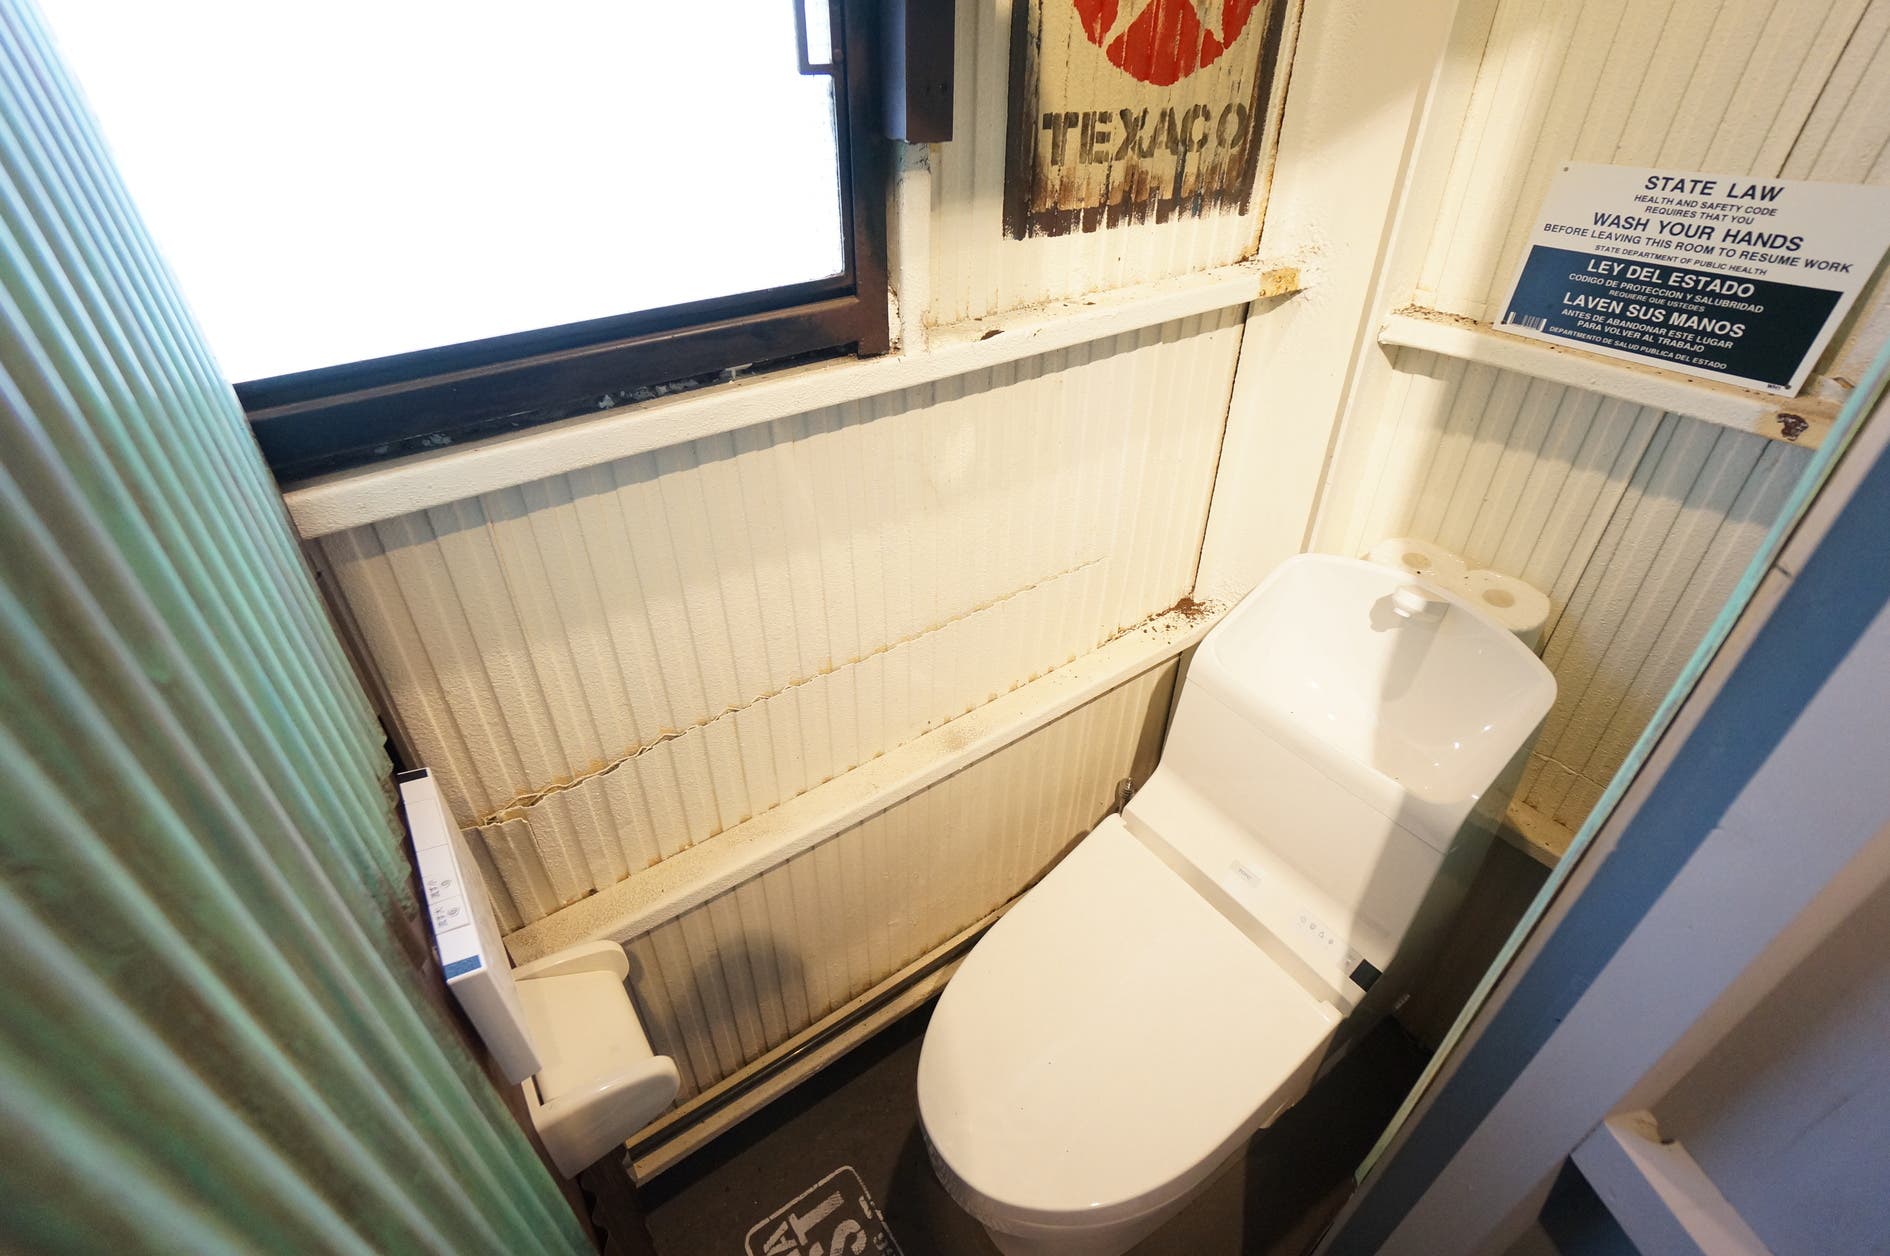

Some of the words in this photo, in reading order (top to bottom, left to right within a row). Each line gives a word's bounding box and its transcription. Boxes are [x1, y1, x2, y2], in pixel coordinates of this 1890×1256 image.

[1042, 102, 1250, 166] TEXACO
[1634, 194, 1674, 206] HEALTH
[1675, 199, 1698, 208] AND
[1700, 202, 1743, 212] SAFETY
[1745, 206, 1778, 216] CODE
[1645, 175, 1717, 196] STATE
[1726, 183, 1785, 201] LAW
[1593, 212, 1650, 232] WASH
[1658, 220, 1715, 241] YOUR
[1722, 228, 1804, 252] HANDS
[1644, 205, 1697, 219] REQUIRES
[1700, 212, 1728, 222] THAT
[1731, 216, 1755, 225] YOU
[1544, 223, 1588, 237] BEFORE
[1591, 229, 1642, 245] LEAVING
[1645, 237, 1672, 249] THIS
[1674, 241, 1715, 255] ROOM
[1718, 247, 1736, 258] TO
[1739, 250, 1801, 267] RESUME
[1804, 259, 1854, 273] WORK
[1594, 244, 1621, 255] STATE
[1621, 248, 1679, 263] DEPARTMENT
[1680, 257, 1692, 265] OF
[1693, 259, 1727, 270] PUBLIC
[1728, 265, 1768, 276] HEALTH
[1569, 273, 1604, 285] CODIGO
[1605, 279, 1619, 288] DE
[1620, 282, 1684, 300] PROTECCION
[1686, 293, 1693, 301] Y
[1694, 295, 1764, 313] SALUBRIDAD
[1587, 259, 1625, 276] LEY
[1626, 265, 1662, 283] DEL
[1668, 272, 1755, 298] ESTADO
[1563, 291, 1624, 314] LAVEN
[1626, 304, 1666, 322] SUS
[1668, 312, 1746, 338] MANOS
[1608, 289, 1648, 302] REQUIERE
[1649, 296, 1666, 305] QUE
[1667, 300, 1705, 312] USTEDES
[1561, 308, 1591, 320] ANTES
[1592, 314, 1606, 323] DE
[1606, 318, 1667, 336] ABANDONAR
[1668, 330, 1695, 341] ESTE
[1696, 335, 1734, 349] LUGAR
[1577, 320, 1602, 331] PARA
[1604, 325, 1641, 339] VOLVER
[1642, 334, 1654, 342] AL
[1658, 336, 1705, 353] TRABAJO
[1602, 337, 1612, 345] DE
[1613, 340, 1640, 351] SALUD
[1640, 345, 1674, 358] PUBLICA
[1674, 353, 1691, 362] DEL
[1692, 357, 1727, 370] ESTADO
